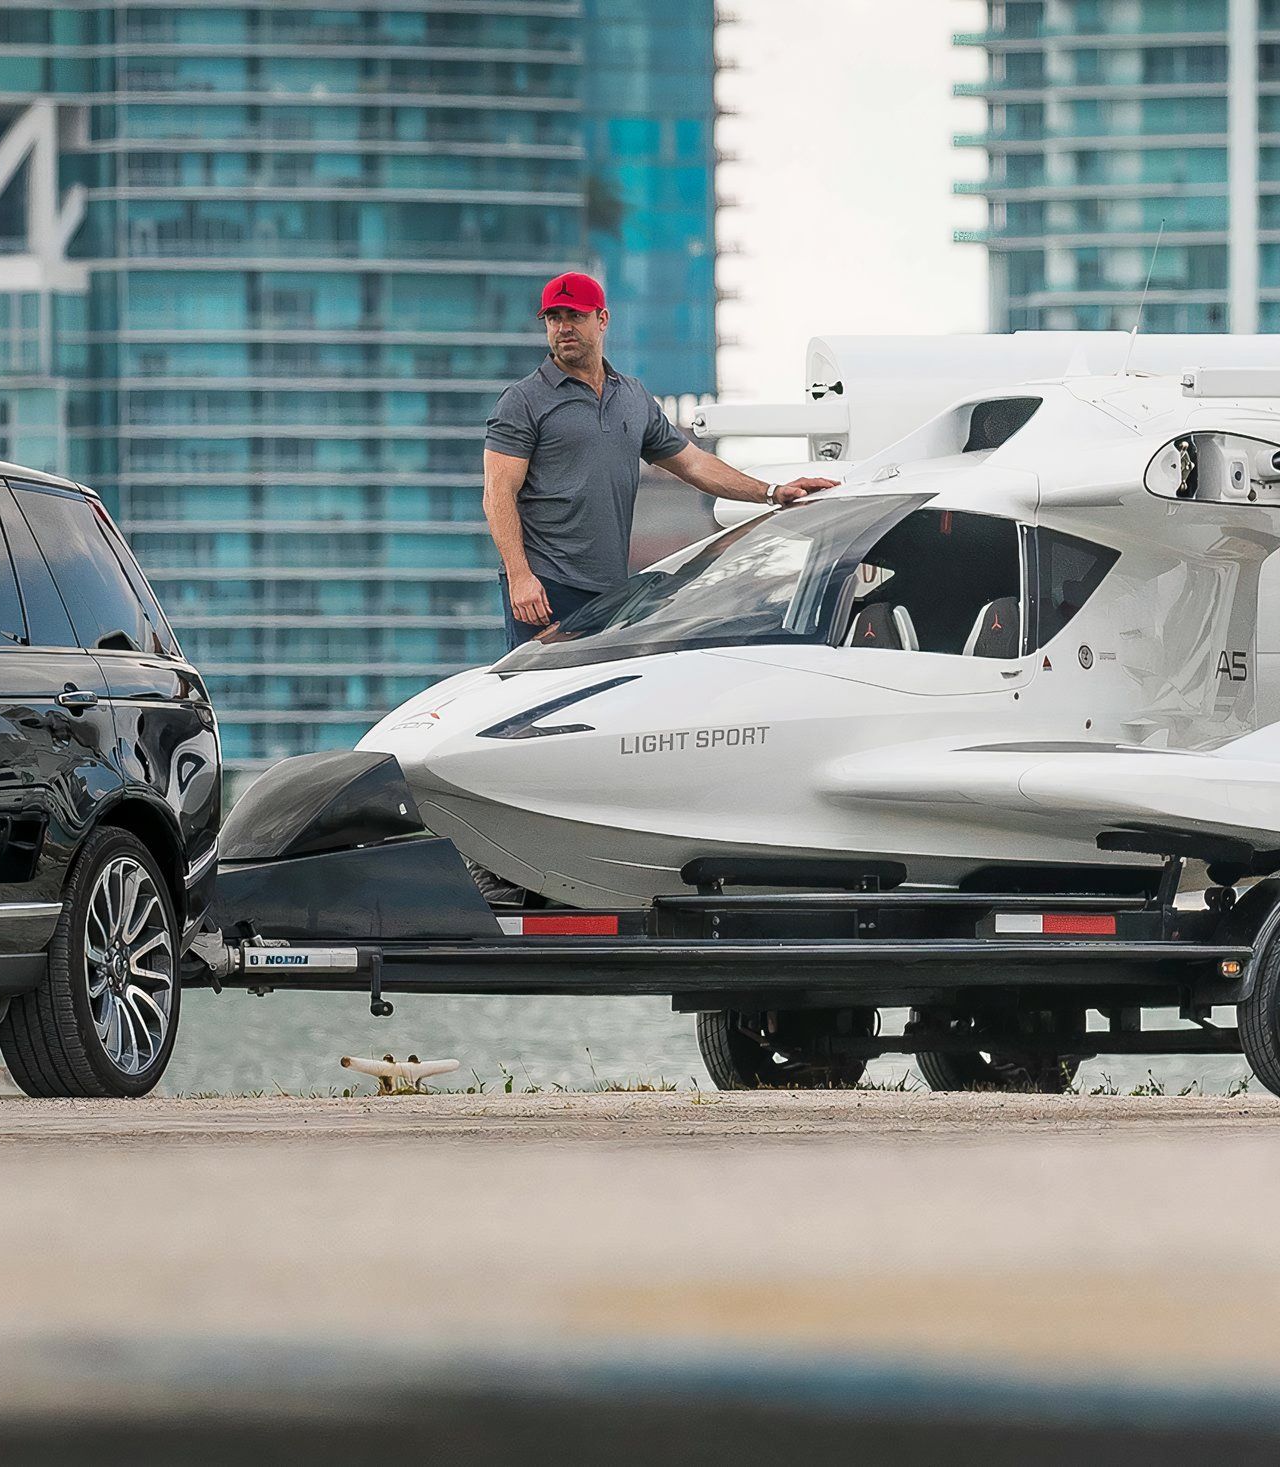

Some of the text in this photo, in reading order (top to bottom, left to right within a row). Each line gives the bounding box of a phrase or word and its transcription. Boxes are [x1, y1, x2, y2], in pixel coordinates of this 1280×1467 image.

[1214, 650, 1248, 681] A5
[620, 726, 771, 755] LIGHT SPORT
